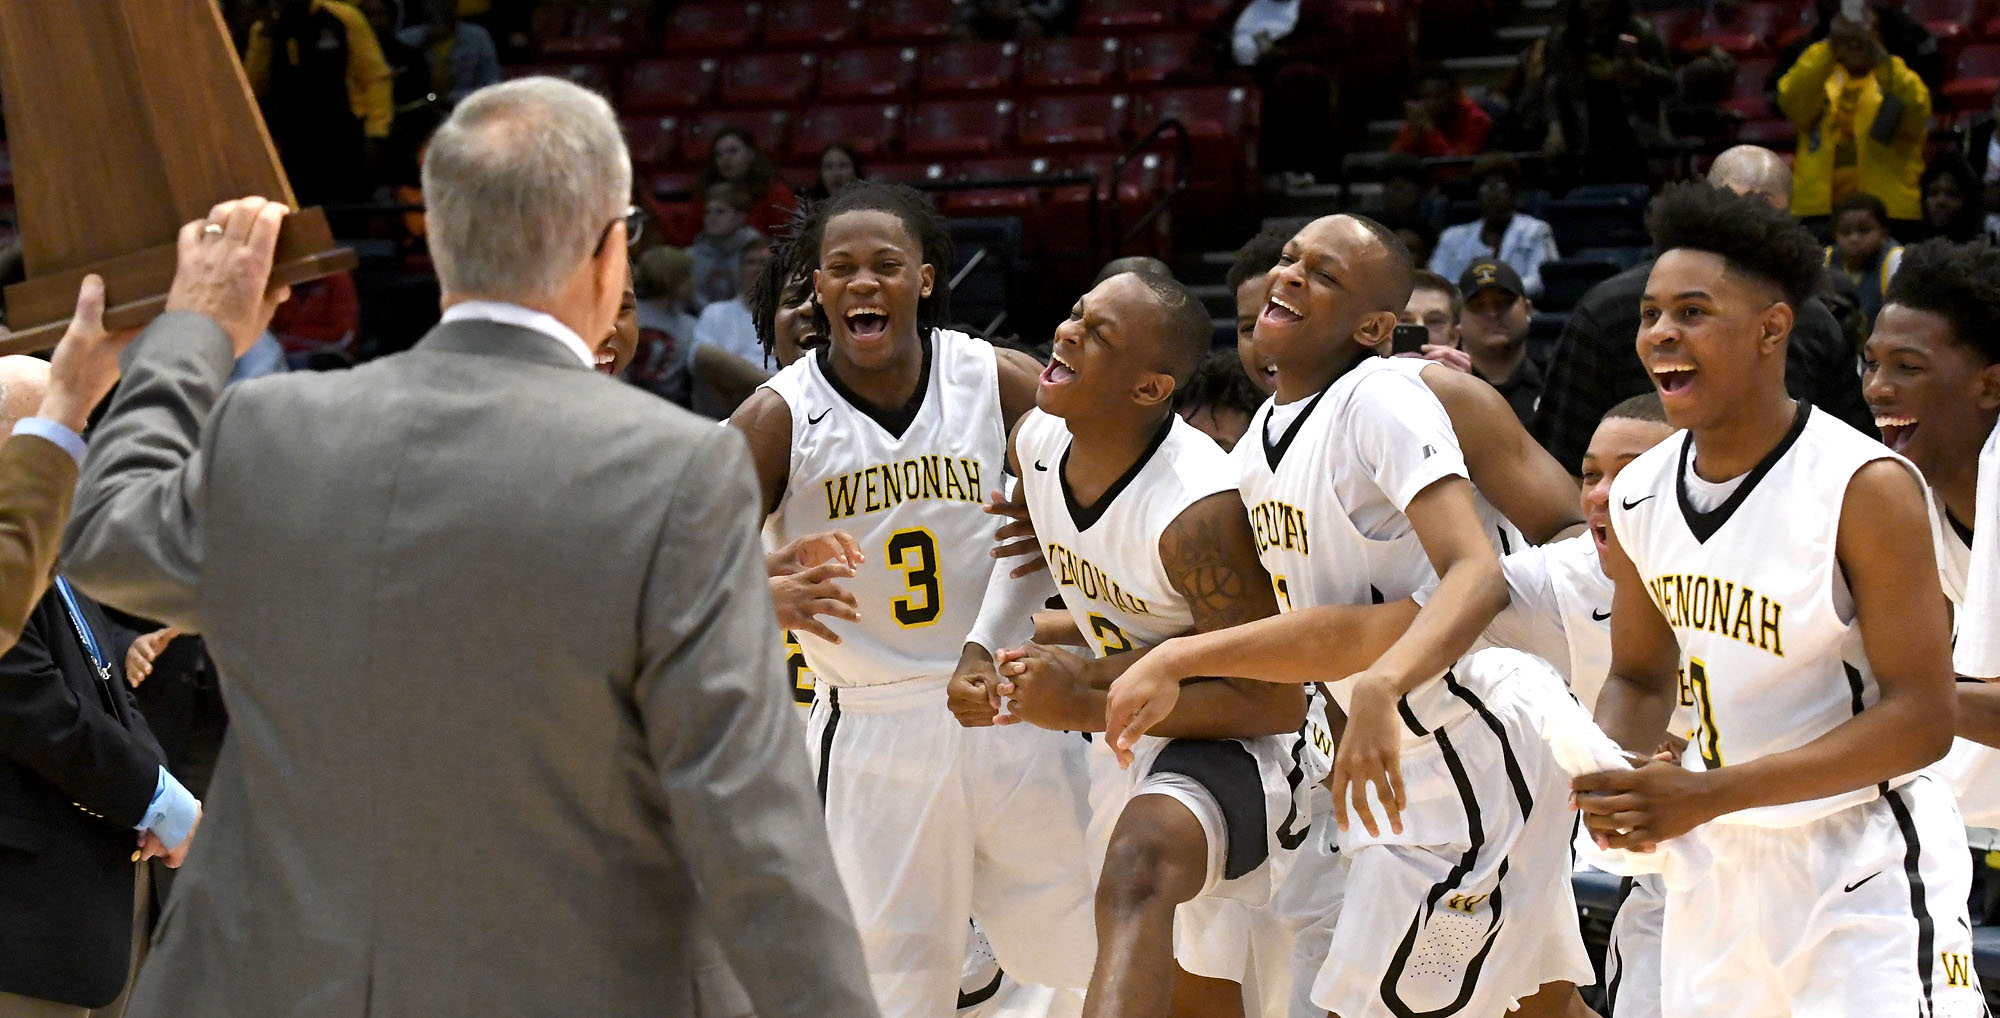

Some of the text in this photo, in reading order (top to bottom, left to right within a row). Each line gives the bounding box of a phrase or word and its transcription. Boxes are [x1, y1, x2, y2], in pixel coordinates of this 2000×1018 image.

[824, 455, 983, 520] WENONAH
[884, 525, 944, 630] 3
[1313, 722, 1332, 758] W
[1941, 952, 1970, 988] W
